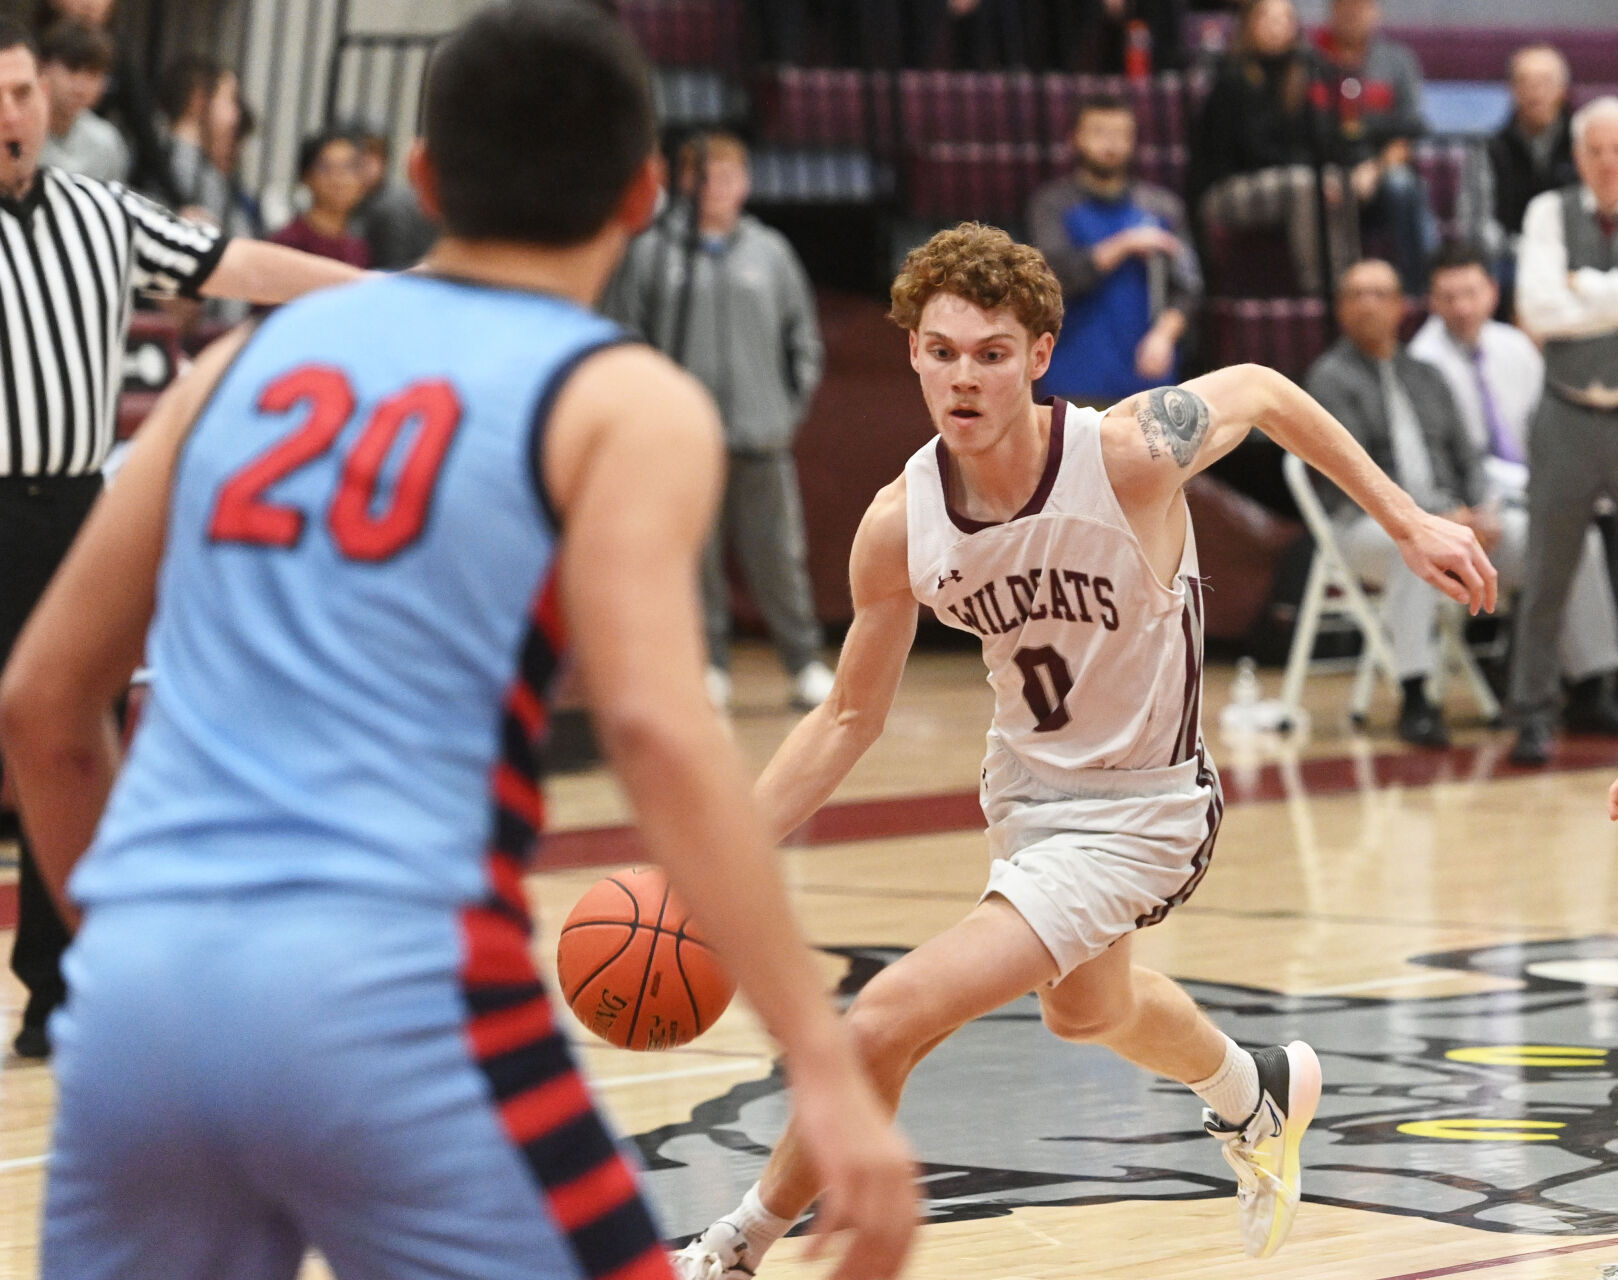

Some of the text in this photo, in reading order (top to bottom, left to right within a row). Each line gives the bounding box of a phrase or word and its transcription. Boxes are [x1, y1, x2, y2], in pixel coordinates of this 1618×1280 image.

[206, 362, 463, 563] 20
[948, 568, 1119, 635] WILDCATS
[1012, 643, 1075, 732] 0
